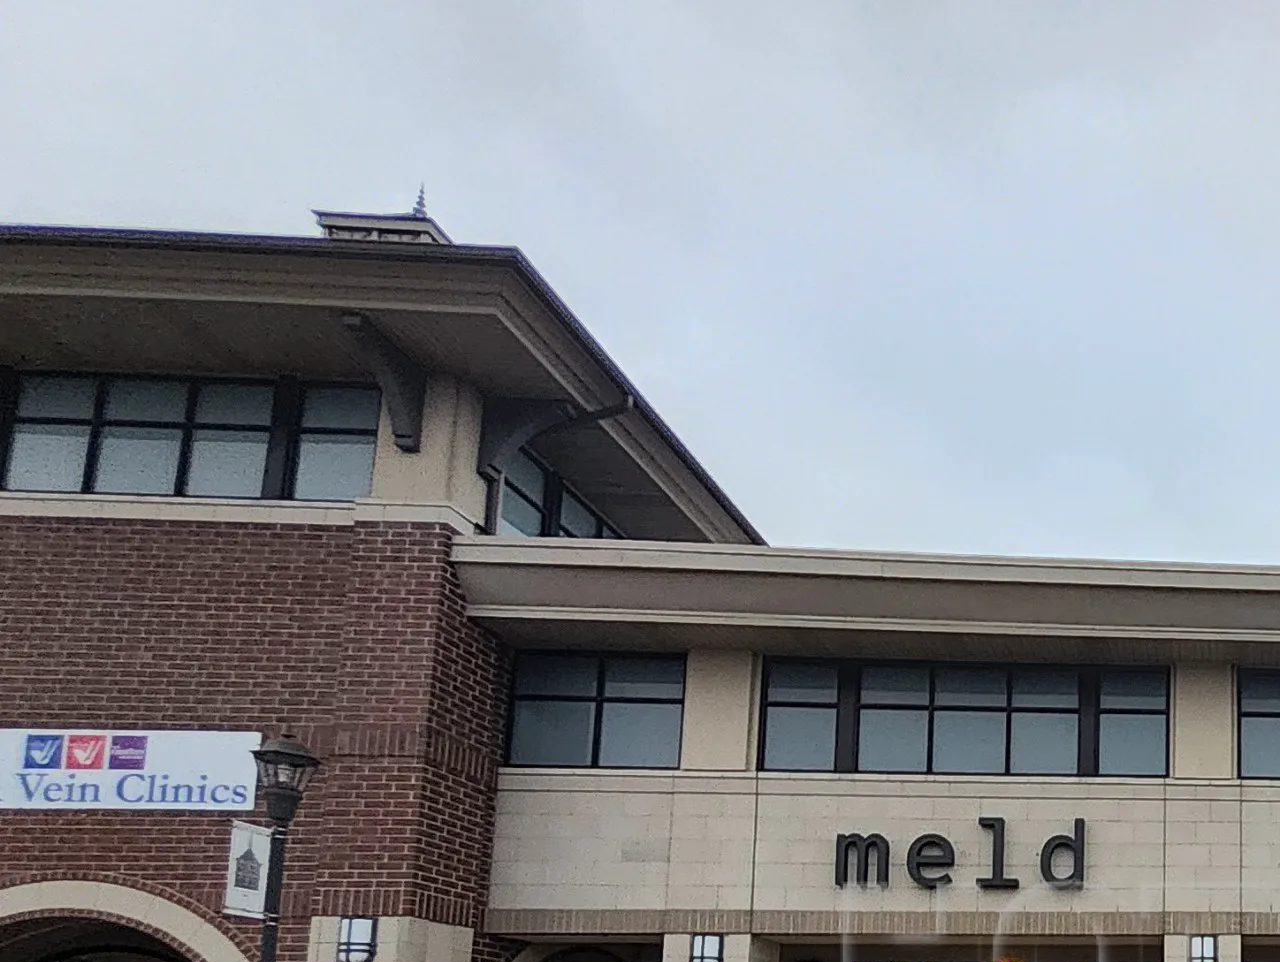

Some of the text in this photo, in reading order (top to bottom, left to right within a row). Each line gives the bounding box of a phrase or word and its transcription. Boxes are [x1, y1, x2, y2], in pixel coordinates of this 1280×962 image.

[16, 772, 248, 805] Vein Clinics
[834, 816, 1086, 890] meld
